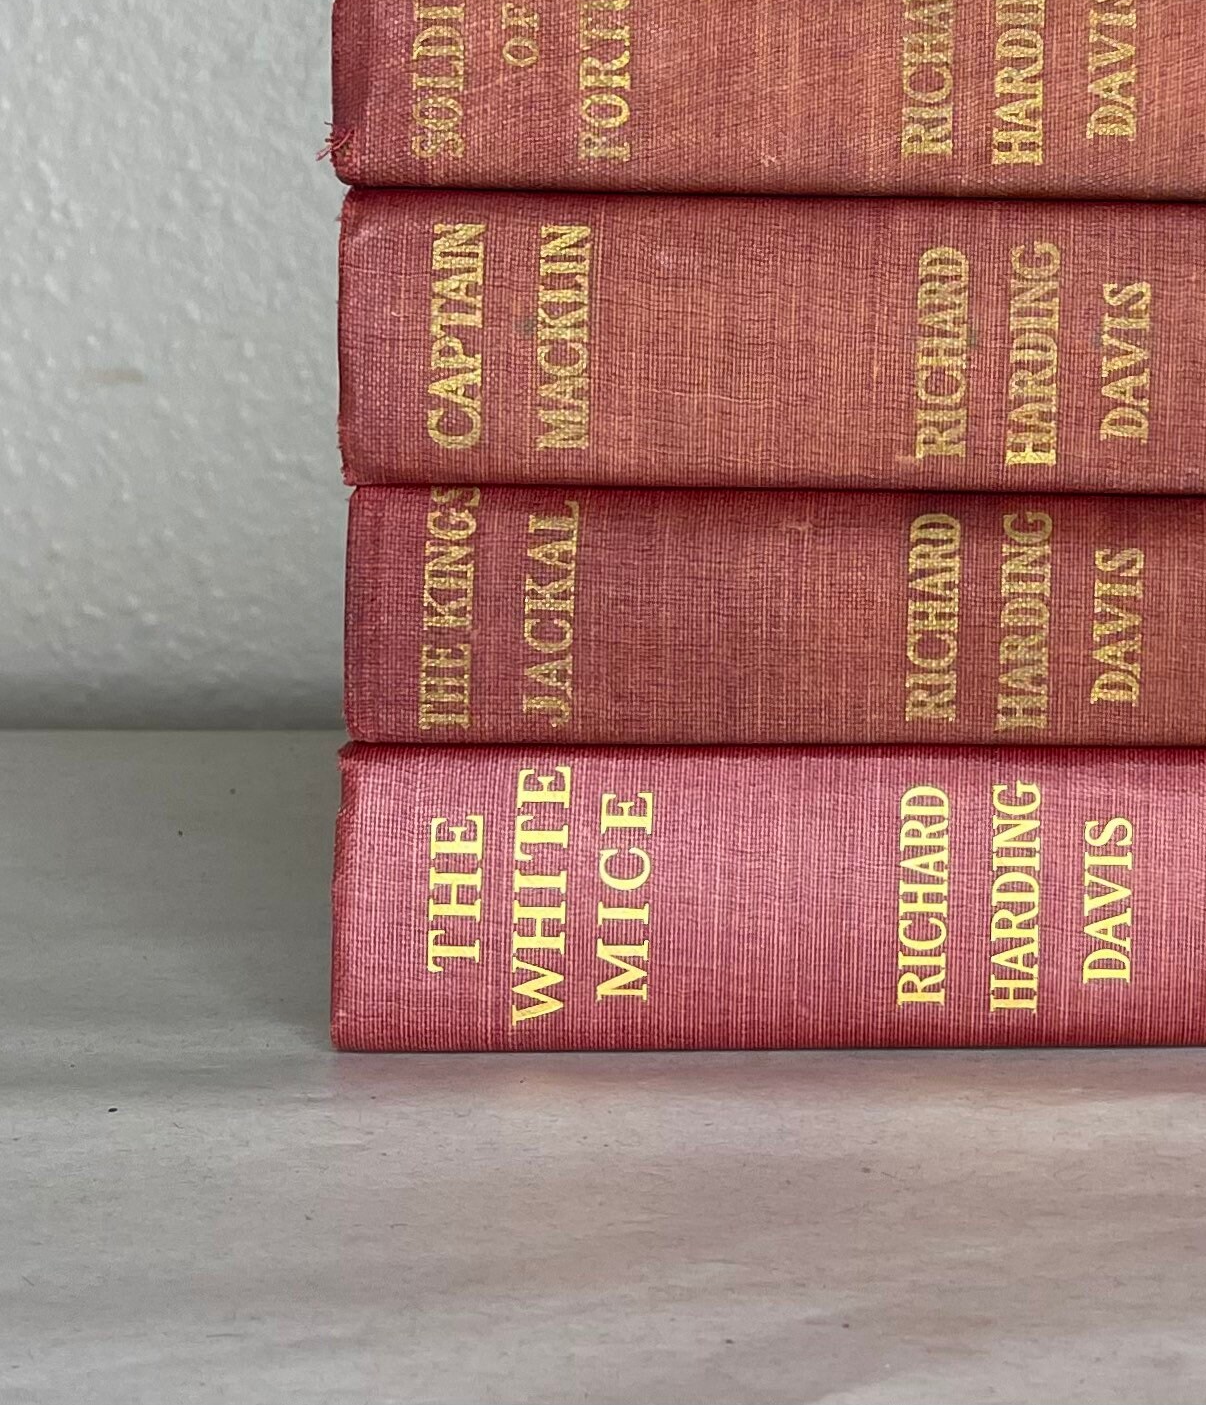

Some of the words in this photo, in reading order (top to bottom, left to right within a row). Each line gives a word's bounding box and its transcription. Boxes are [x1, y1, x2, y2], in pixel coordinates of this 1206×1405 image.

[501, 1, 541, 68] OF
[427, 223, 487, 450] CAPTAIN
[537, 225, 592, 451] MACKLIN
[915, 246, 968, 459] RICHARD
[1005, 241, 1062, 467] HARDING
[1100, 281, 1152, 444] DAVIS
[418, 642, 473, 732] THE
[522, 500, 580, 728] JACKAL
[905, 514, 963, 723] RICHARD
[995, 511, 1053, 731] HARDING
[1091, 547, 1143, 707] DAVIS
[427, 812, 486, 973] THE
[511, 766, 571, 1026] WHITE
[596, 791, 654, 1002] MICE
[897, 785, 949, 1008] RICHARD
[990, 779, 1041, 1015] HARDING
[1084, 816, 1133, 984] DAVIS
